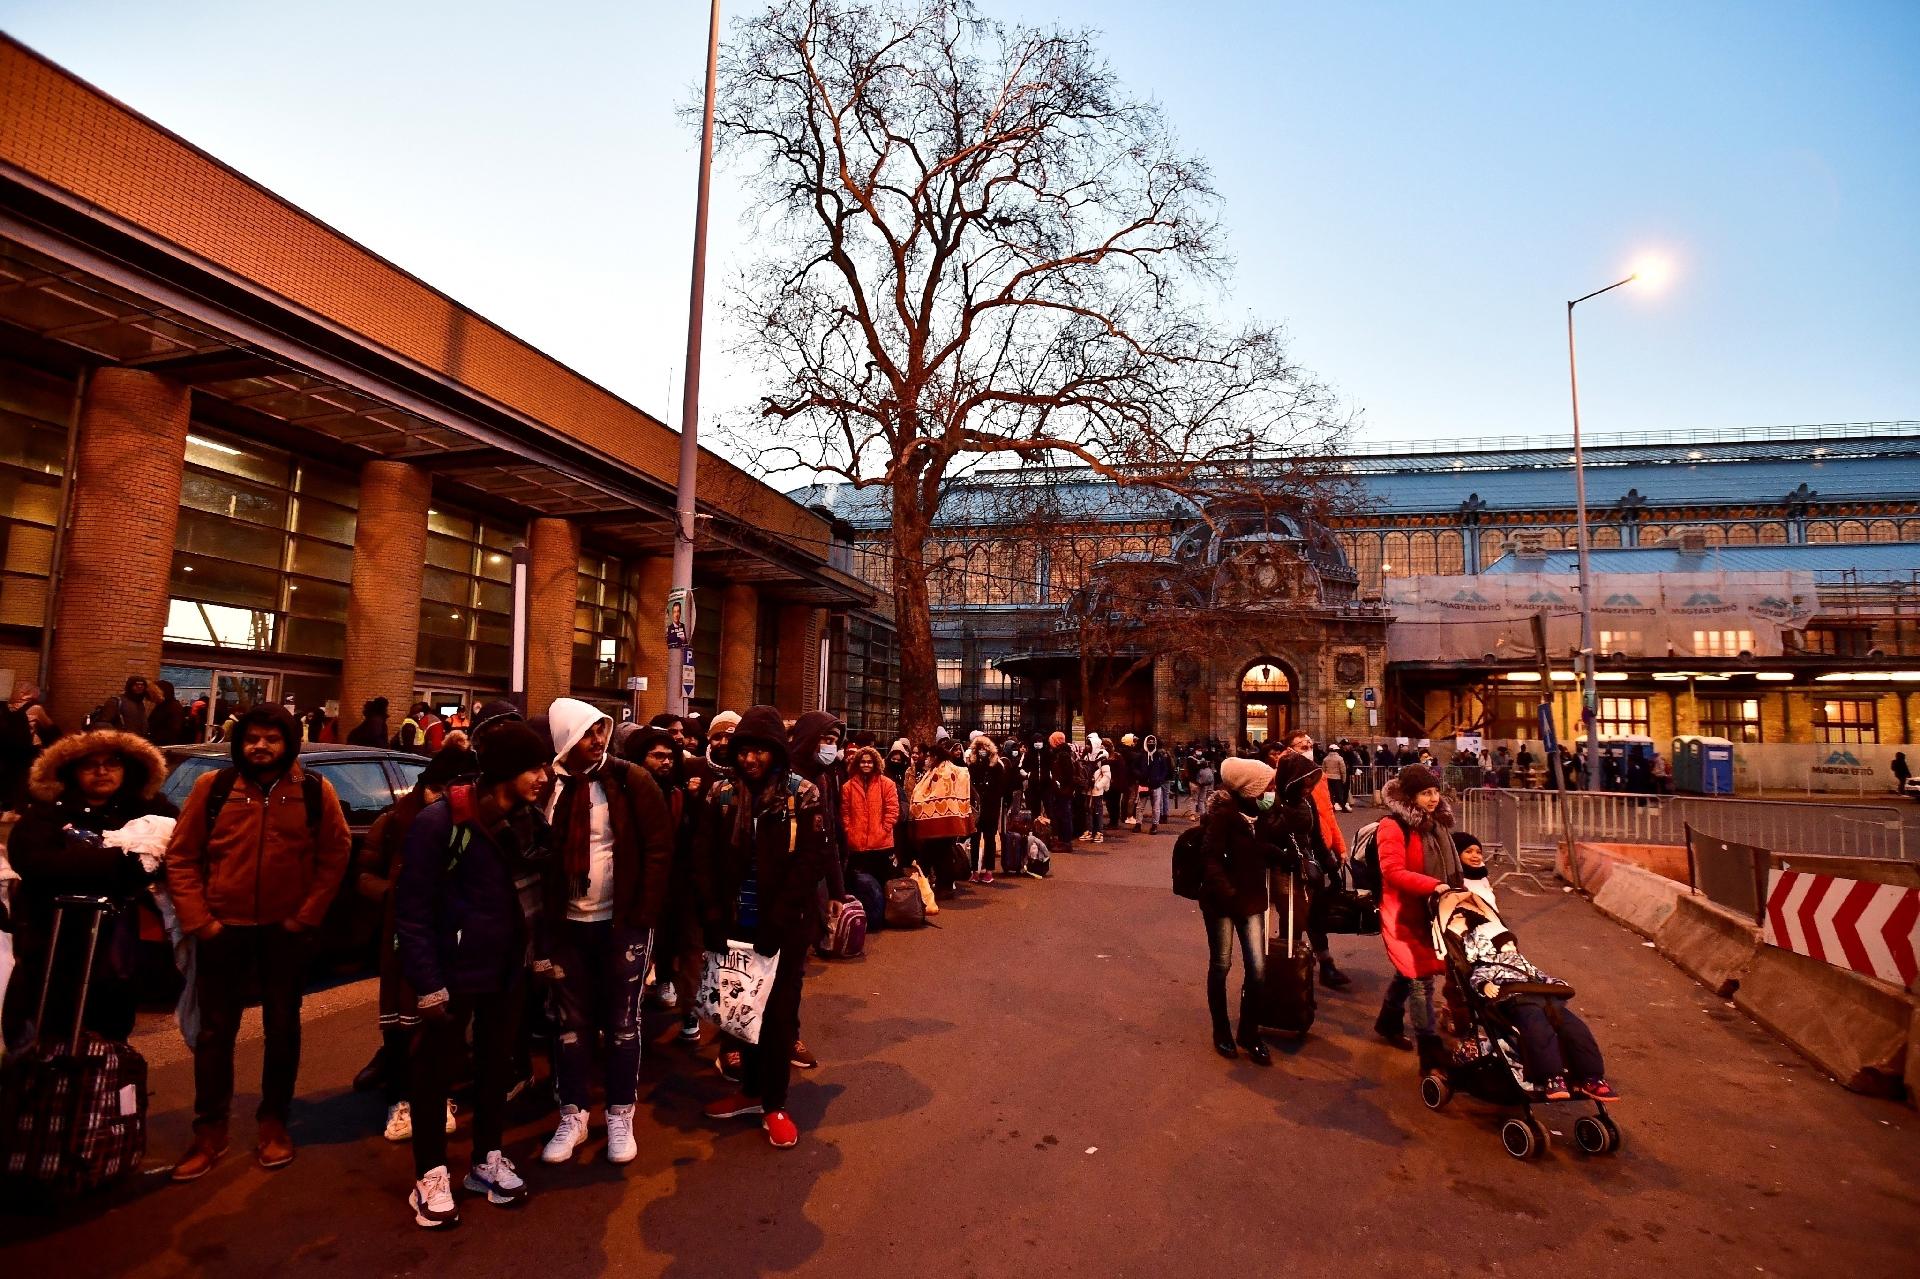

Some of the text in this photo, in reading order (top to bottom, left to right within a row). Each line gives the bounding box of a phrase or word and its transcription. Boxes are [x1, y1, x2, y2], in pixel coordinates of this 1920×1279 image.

[686, 650, 693, 664] P
[1365, 688, 1373, 699] P
[622, 708, 632, 721] P
